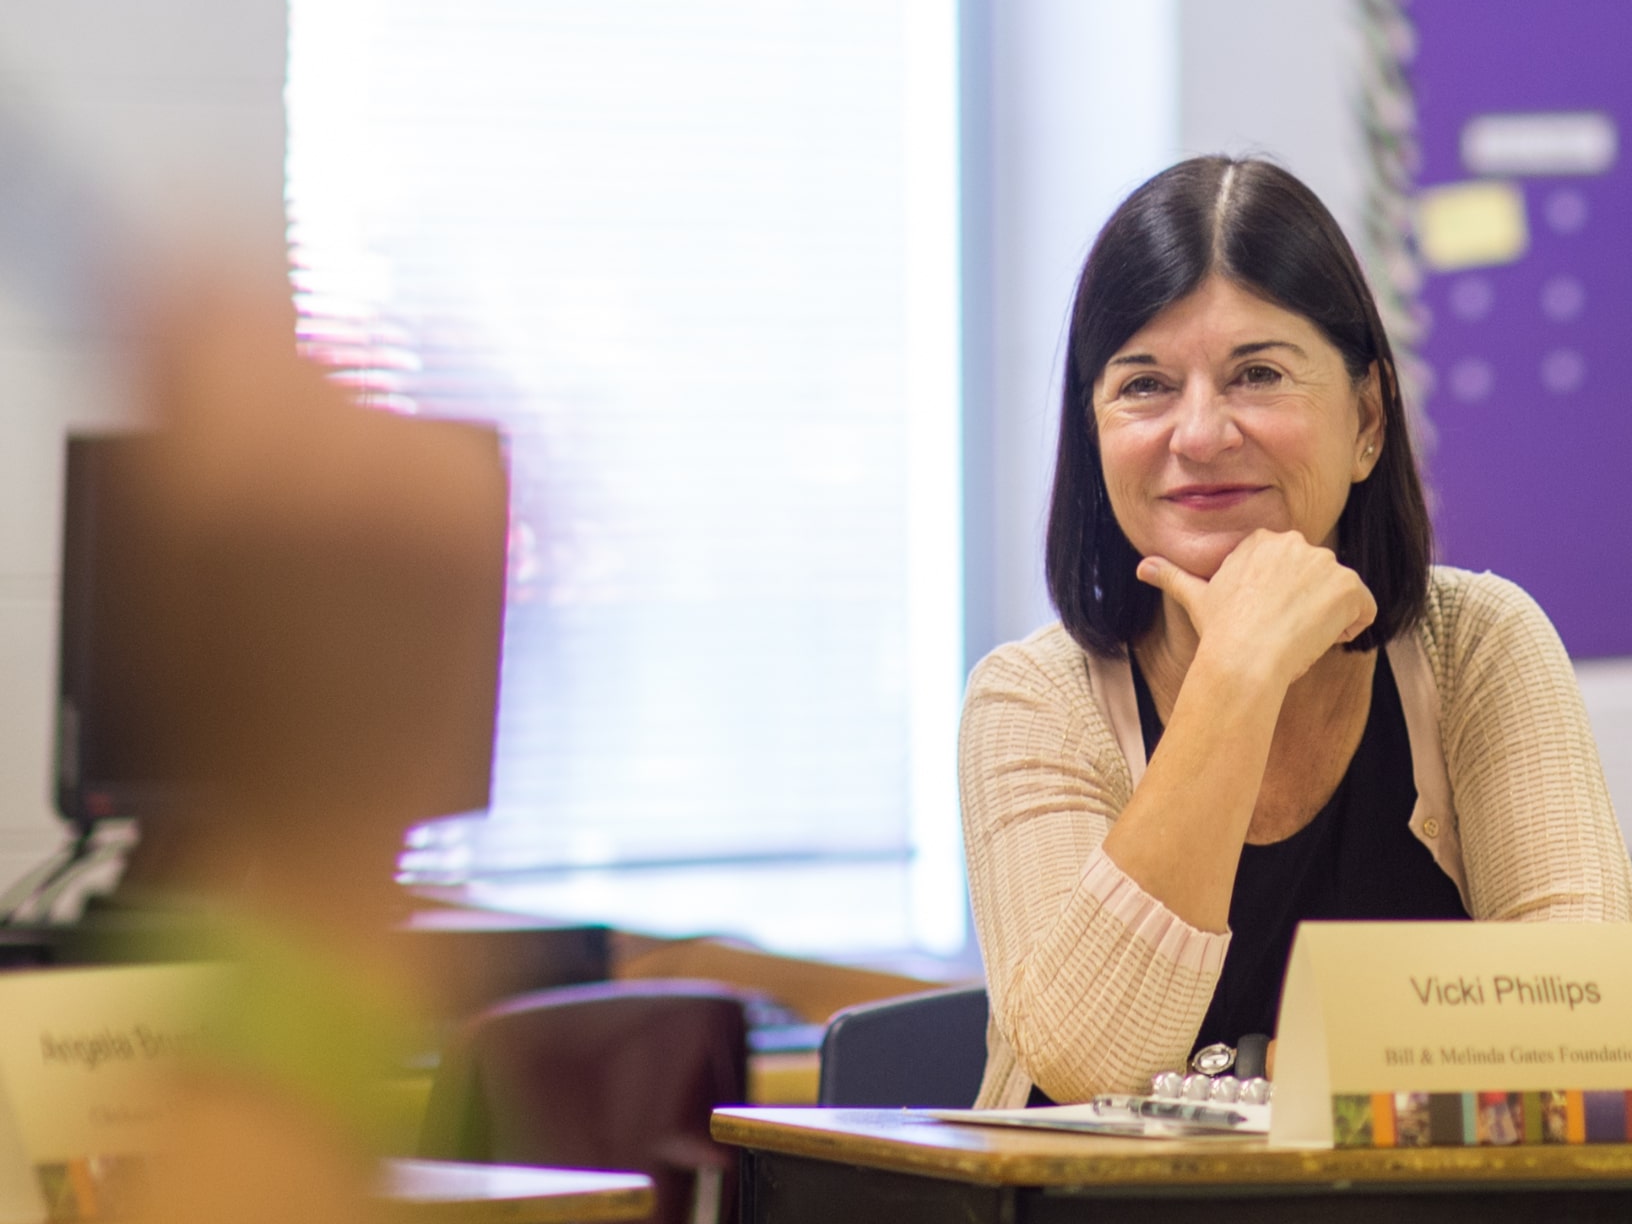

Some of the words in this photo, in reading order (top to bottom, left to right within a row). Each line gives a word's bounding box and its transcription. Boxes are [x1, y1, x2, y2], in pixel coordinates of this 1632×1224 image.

[1409, 976, 1486, 1006] Vicki
[1493, 975, 1602, 1011] Phillips
[1384, 1047, 1415, 1066] Bill
[1420, 1047, 1434, 1065] &
[1440, 1046, 1506, 1066] Melinda
[1510, 1046, 1554, 1065] Gates
